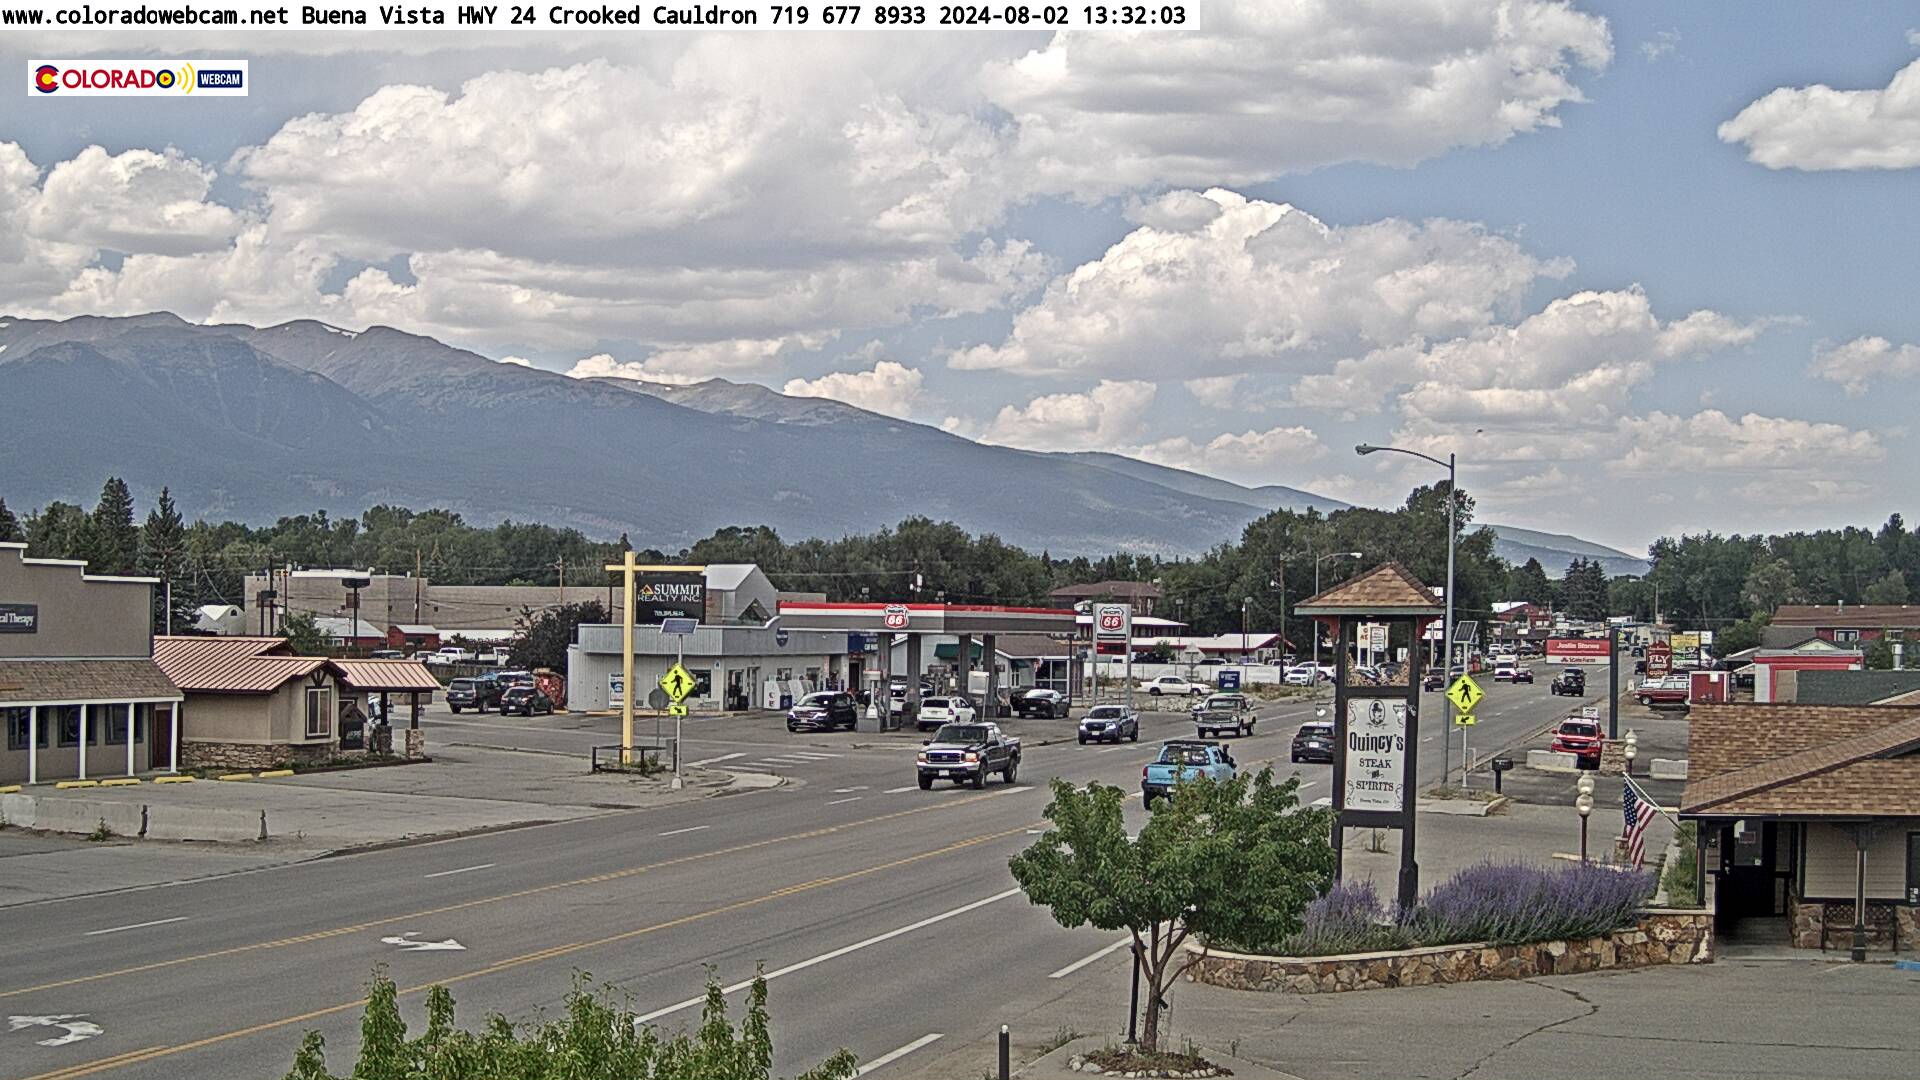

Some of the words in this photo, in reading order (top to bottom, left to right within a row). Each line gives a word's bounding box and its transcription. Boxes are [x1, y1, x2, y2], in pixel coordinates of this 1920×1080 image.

[654, 584, 702, 595] SUMMIT
[638, 594, 678, 602] REALTY
[888, 615, 903, 625] 66
[1103, 616, 1119, 627] 66
[1649, 654, 1670, 664] FLY
[1349, 732, 1404, 754] Quincy's
[1359, 758, 1392, 769] STEAK
[1355, 780, 1394, 791] SPIRITS
